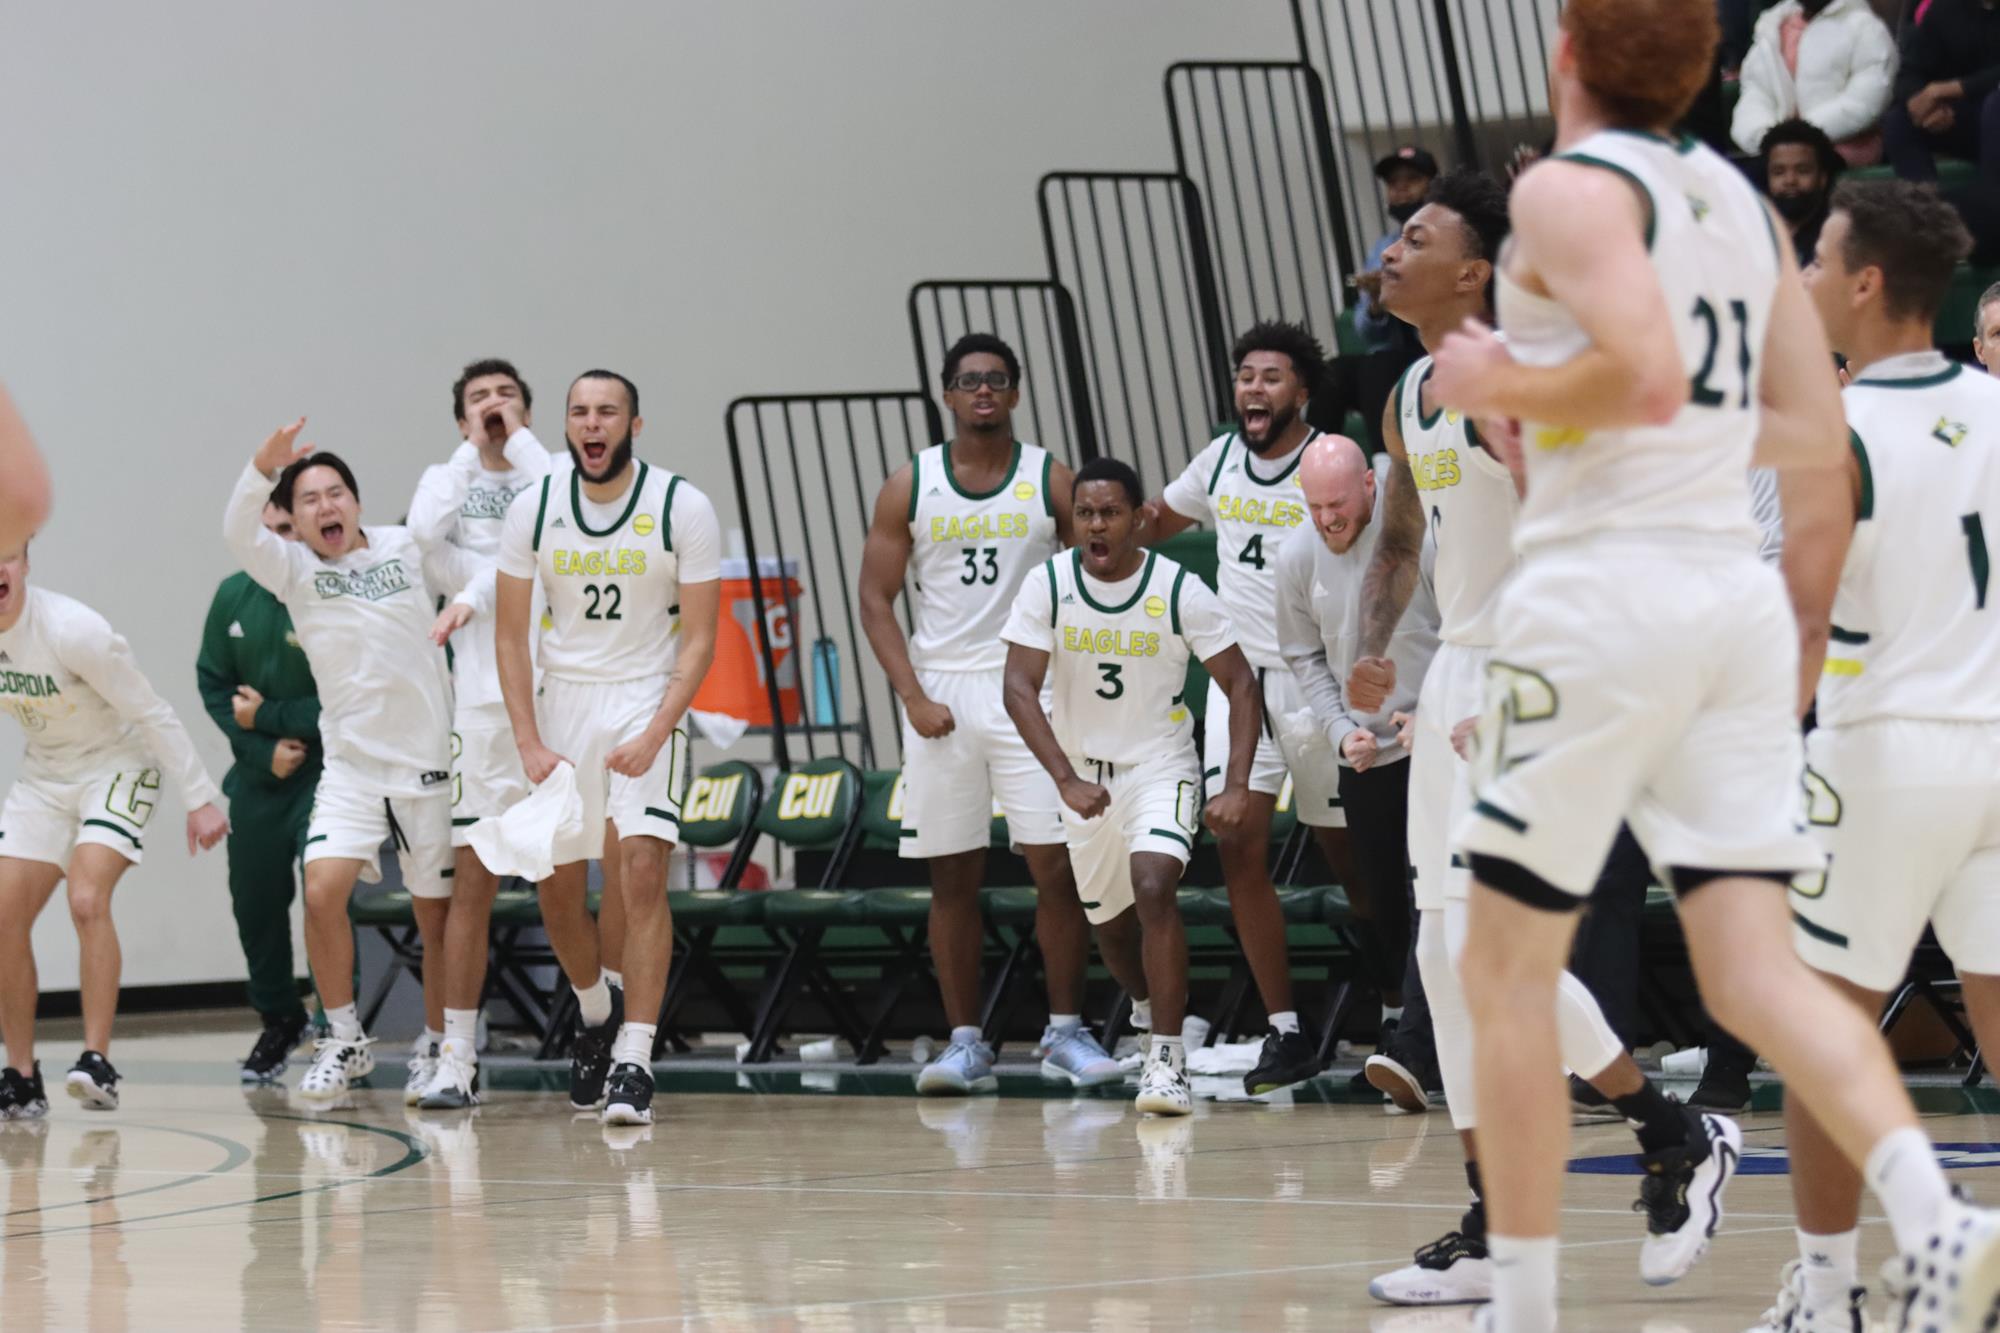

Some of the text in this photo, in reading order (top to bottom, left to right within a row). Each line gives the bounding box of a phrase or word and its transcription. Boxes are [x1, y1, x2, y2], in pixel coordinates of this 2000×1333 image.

[1692, 295, 1750, 408] 21
[930, 512, 1029, 543] EAGLES
[1217, 495, 1305, 528] EAGLES
[553, 549, 647, 575] EAGLES
[960, 547, 999, 586] 33
[1238, 533, 1266, 570] 4
[1960, 511, 1989, 609] 1
[583, 583, 622, 620] 22
[1063, 625, 1161, 657] EAGLES
[1095, 662, 1124, 700] 3
[682, 772, 744, 823] CUI
[778, 770, 845, 820] CUI
